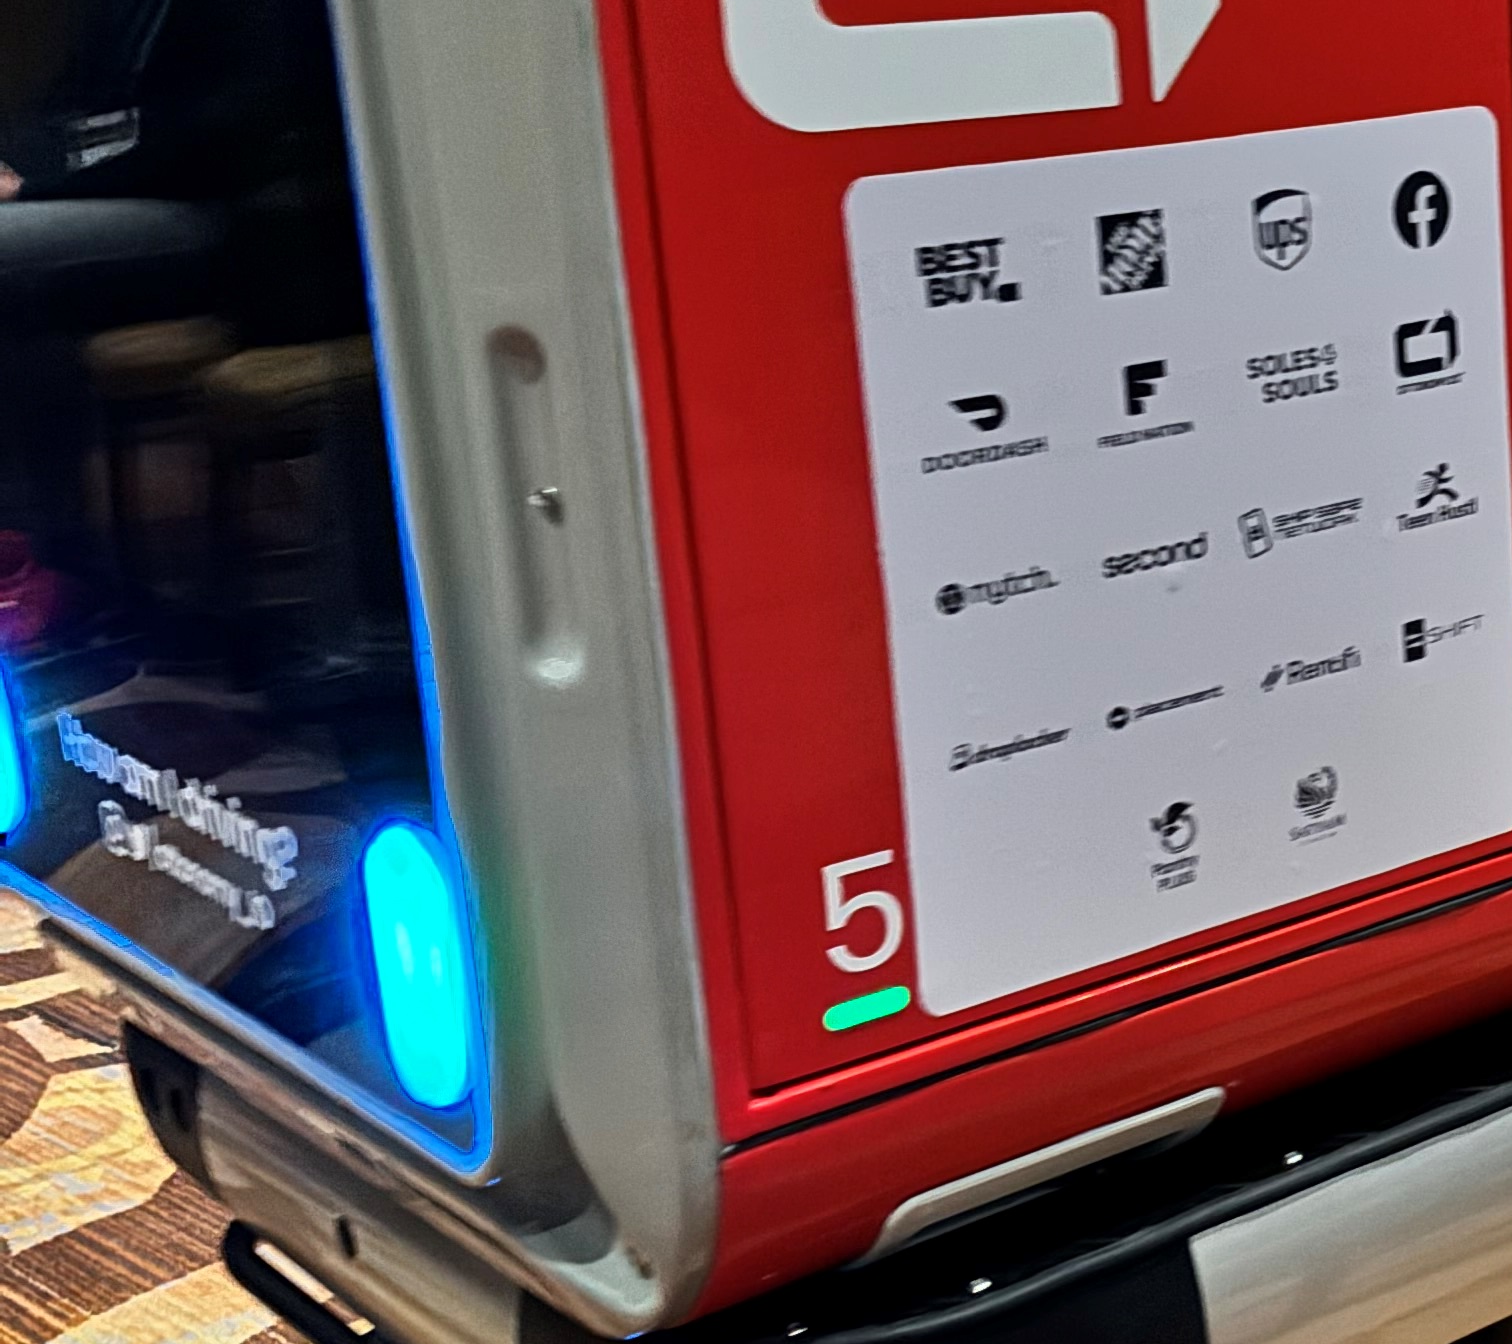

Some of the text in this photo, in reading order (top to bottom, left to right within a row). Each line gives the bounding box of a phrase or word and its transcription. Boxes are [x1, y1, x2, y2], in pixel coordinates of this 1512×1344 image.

[914, 236, 1004, 278] BEST
[1261, 370, 1339, 404] SOULS
[920, 435, 1049, 474] DOORDASH
[1101, 531, 1209, 578] second
[1426, 613, 1486, 646] SHIFT
[820, 848, 904, 974] 5
